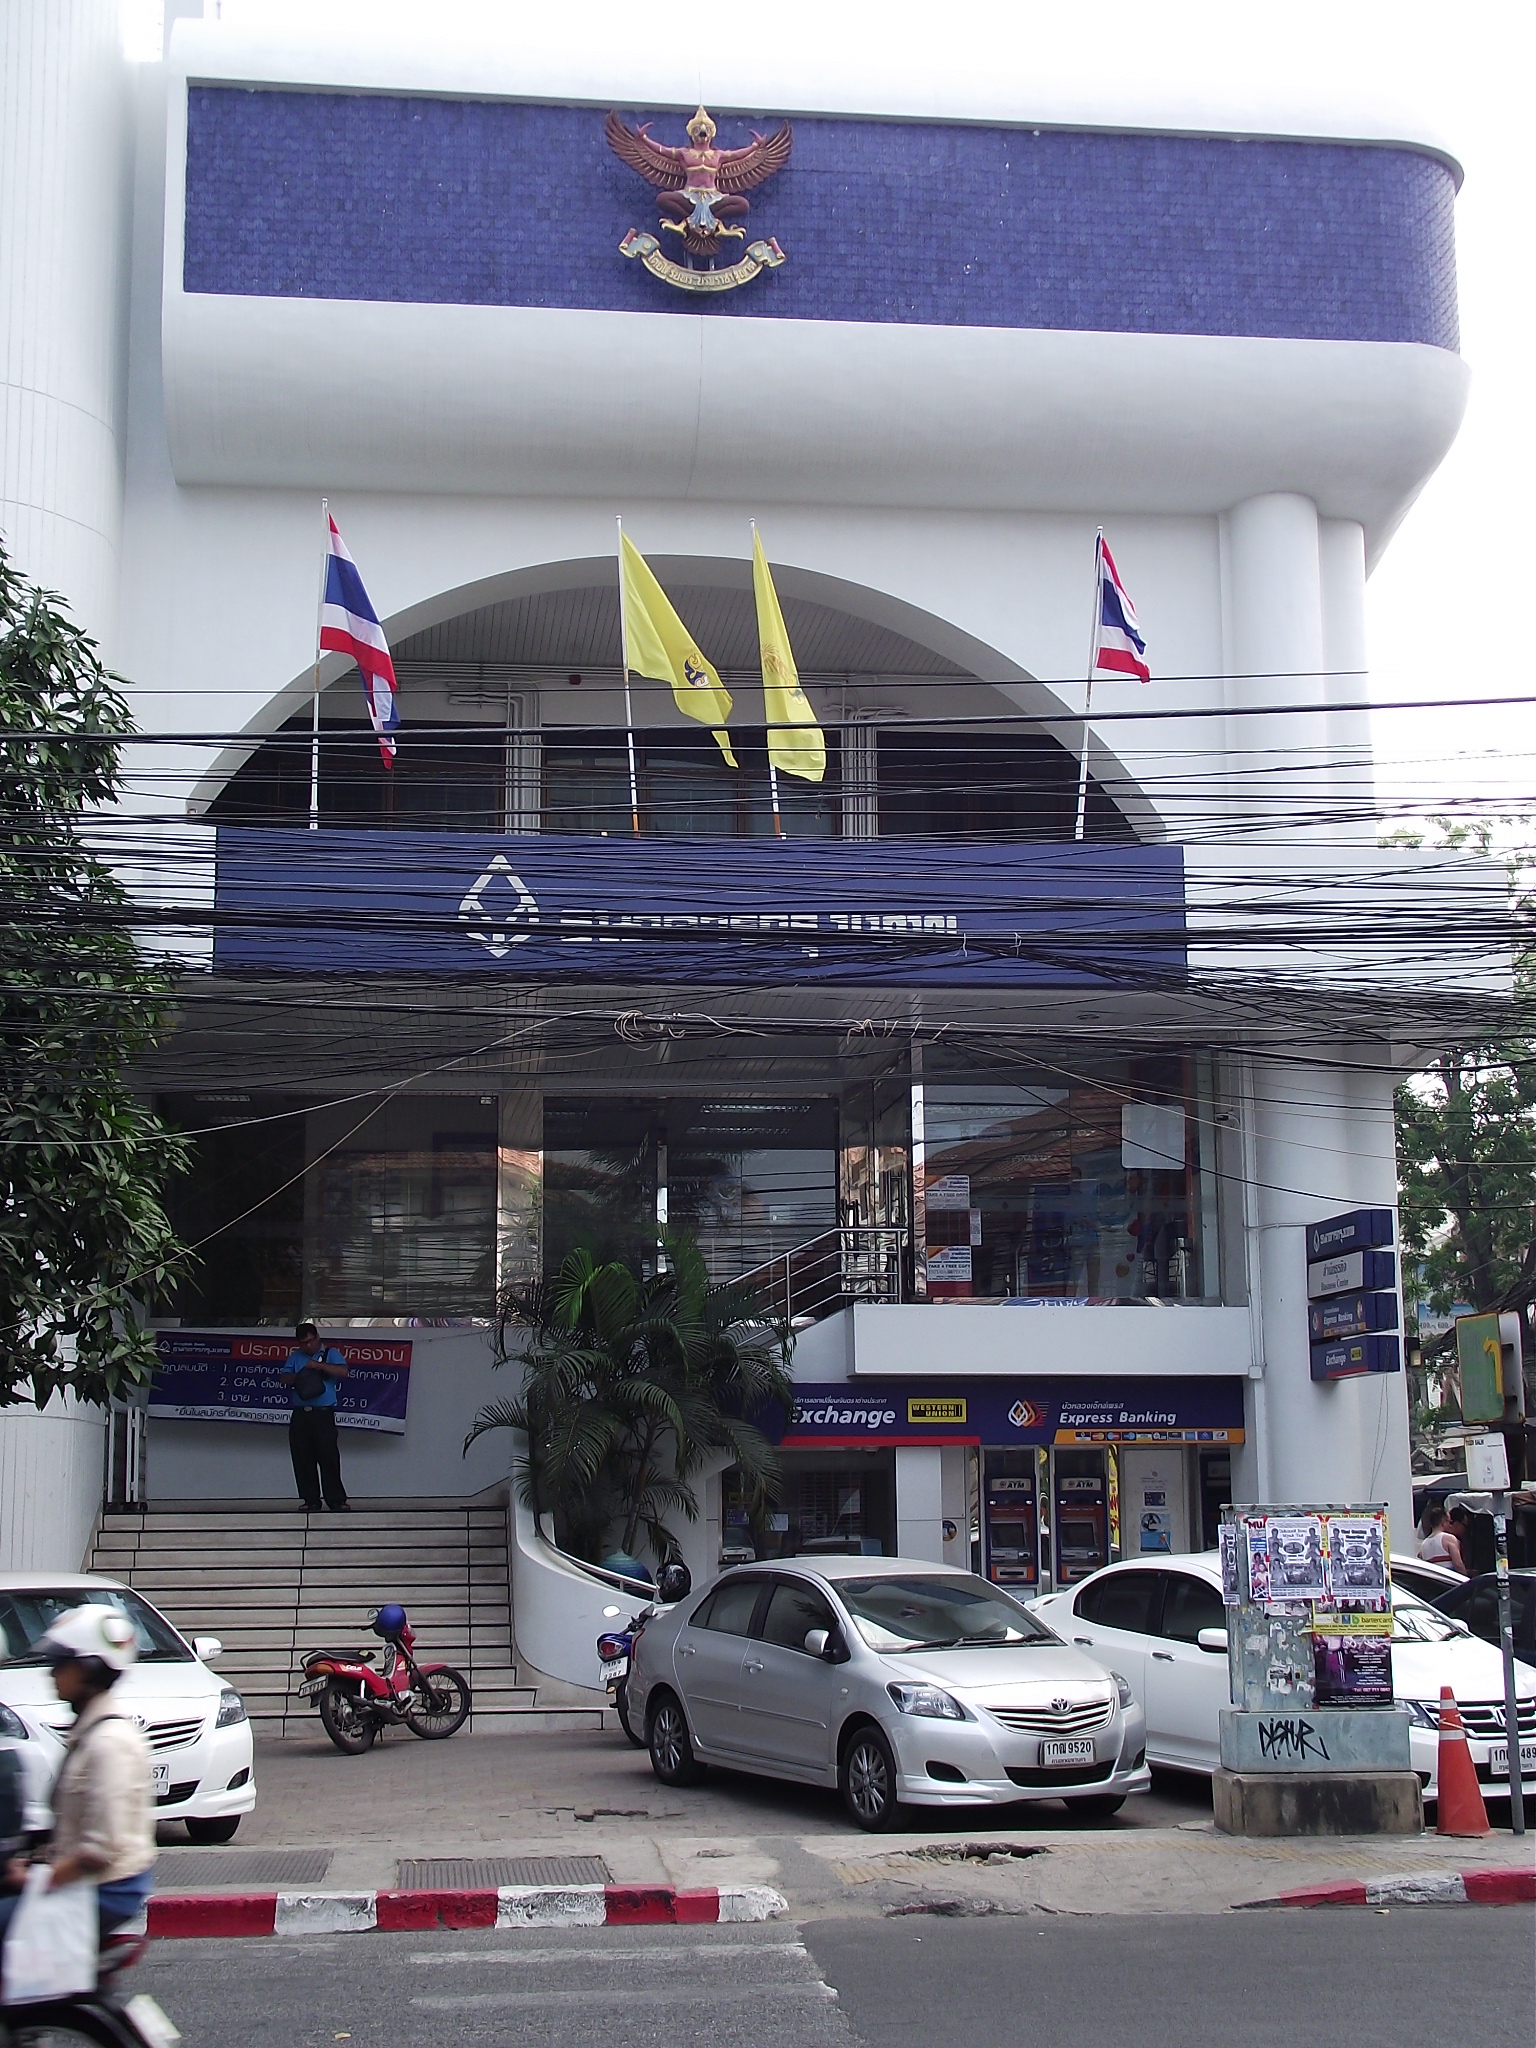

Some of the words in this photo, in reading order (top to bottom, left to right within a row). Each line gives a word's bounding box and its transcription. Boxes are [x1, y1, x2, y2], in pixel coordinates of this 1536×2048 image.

[233, 1378, 257, 1388] GPA
[342, 1397, 356, 1408] 25
[792, 1406, 896, 1429] Exchange
[1059, 1412, 1113, 1426] Express
[1119, 1411, 1177, 1426] Banking
[1068, 1741, 1091, 1754] 9520
